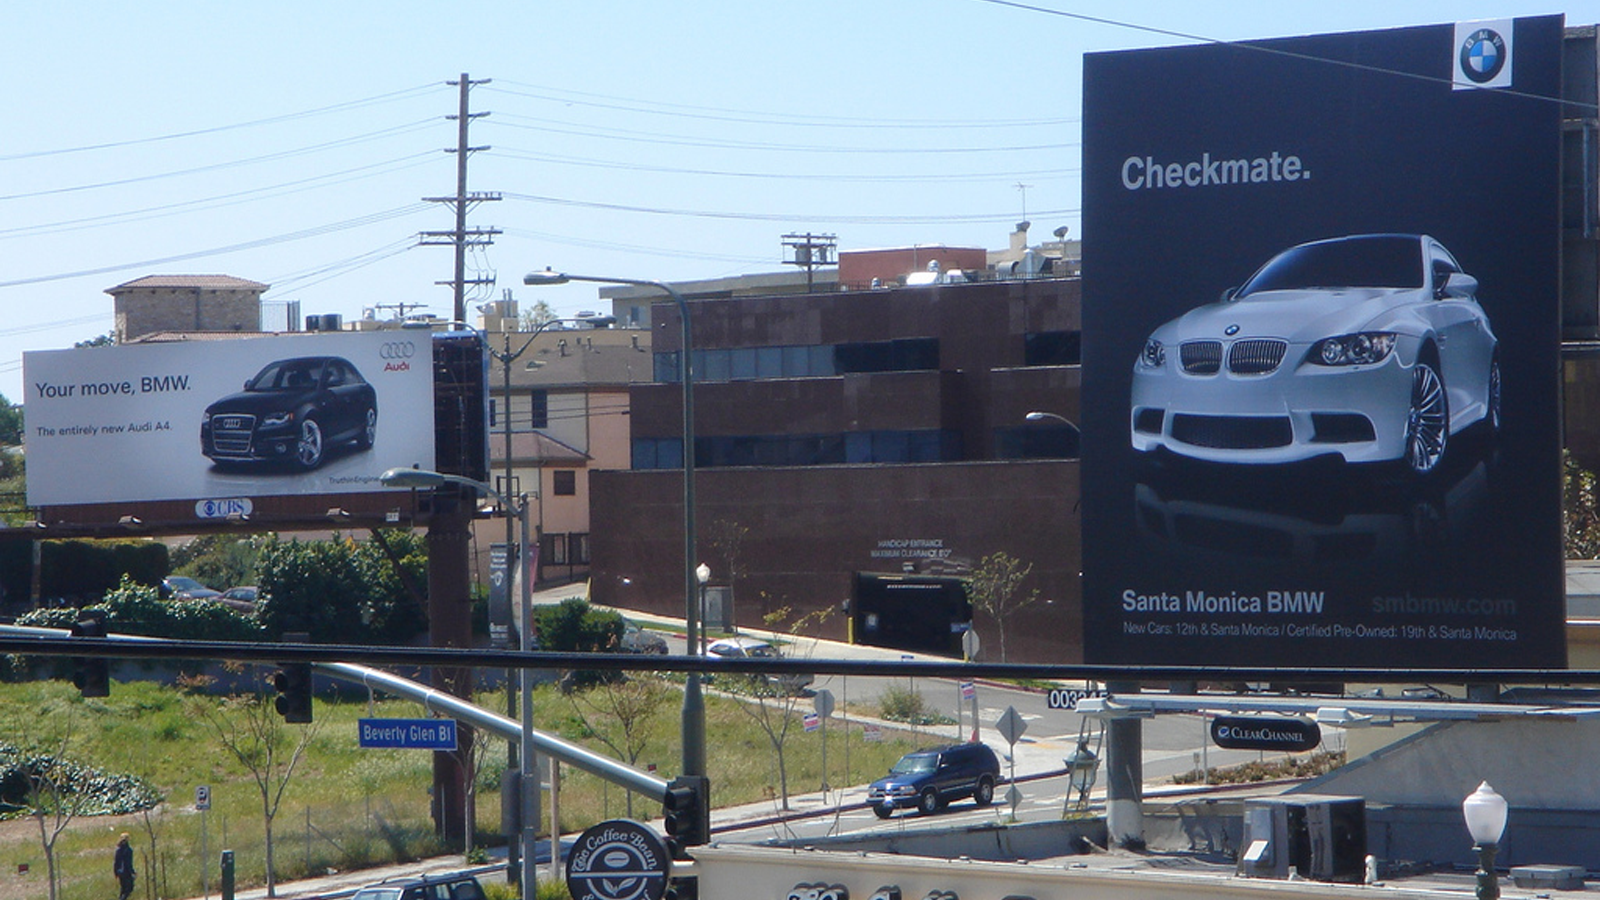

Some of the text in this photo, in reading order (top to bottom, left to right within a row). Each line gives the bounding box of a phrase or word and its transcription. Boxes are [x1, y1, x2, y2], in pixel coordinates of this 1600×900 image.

[1465, 30, 1503, 49] BMW
[1121, 151, 1311, 190] Checkmate.
[384, 360, 410, 372] Audi
[35, 374, 191, 398] Your move, BMW.
[37, 421, 173, 437] The entirely new Audi A4.
[217, 499, 245, 515] CBS
[910, 539, 943, 548] ENTRANCE
[1122, 589, 1325, 614] Santa Monica BMW
[1371, 592, 1517, 616] smbmw.com
[1123, 621, 1145, 634] New
[1147, 622, 1173, 635] Cars:
[1176, 622, 1199, 635] 12th
[1200, 623, 1209, 636] &
[1210, 623, 1240, 636] Santa
[1241, 623, 1279, 637] Monica
[1287, 624, 1332, 637] Certified
[1333, 624, 1398, 638] Pre-Owned:
[1400, 625, 1426, 639] 19th
[1428, 626, 1438, 639] &
[1440, 626, 1472, 639] Santa
[1474, 627, 1517, 641] Monica
[363, 725, 407, 744] Beverly
[410, 725, 435, 741] Glen
[571, 828, 658, 872] The Coffee Bean
